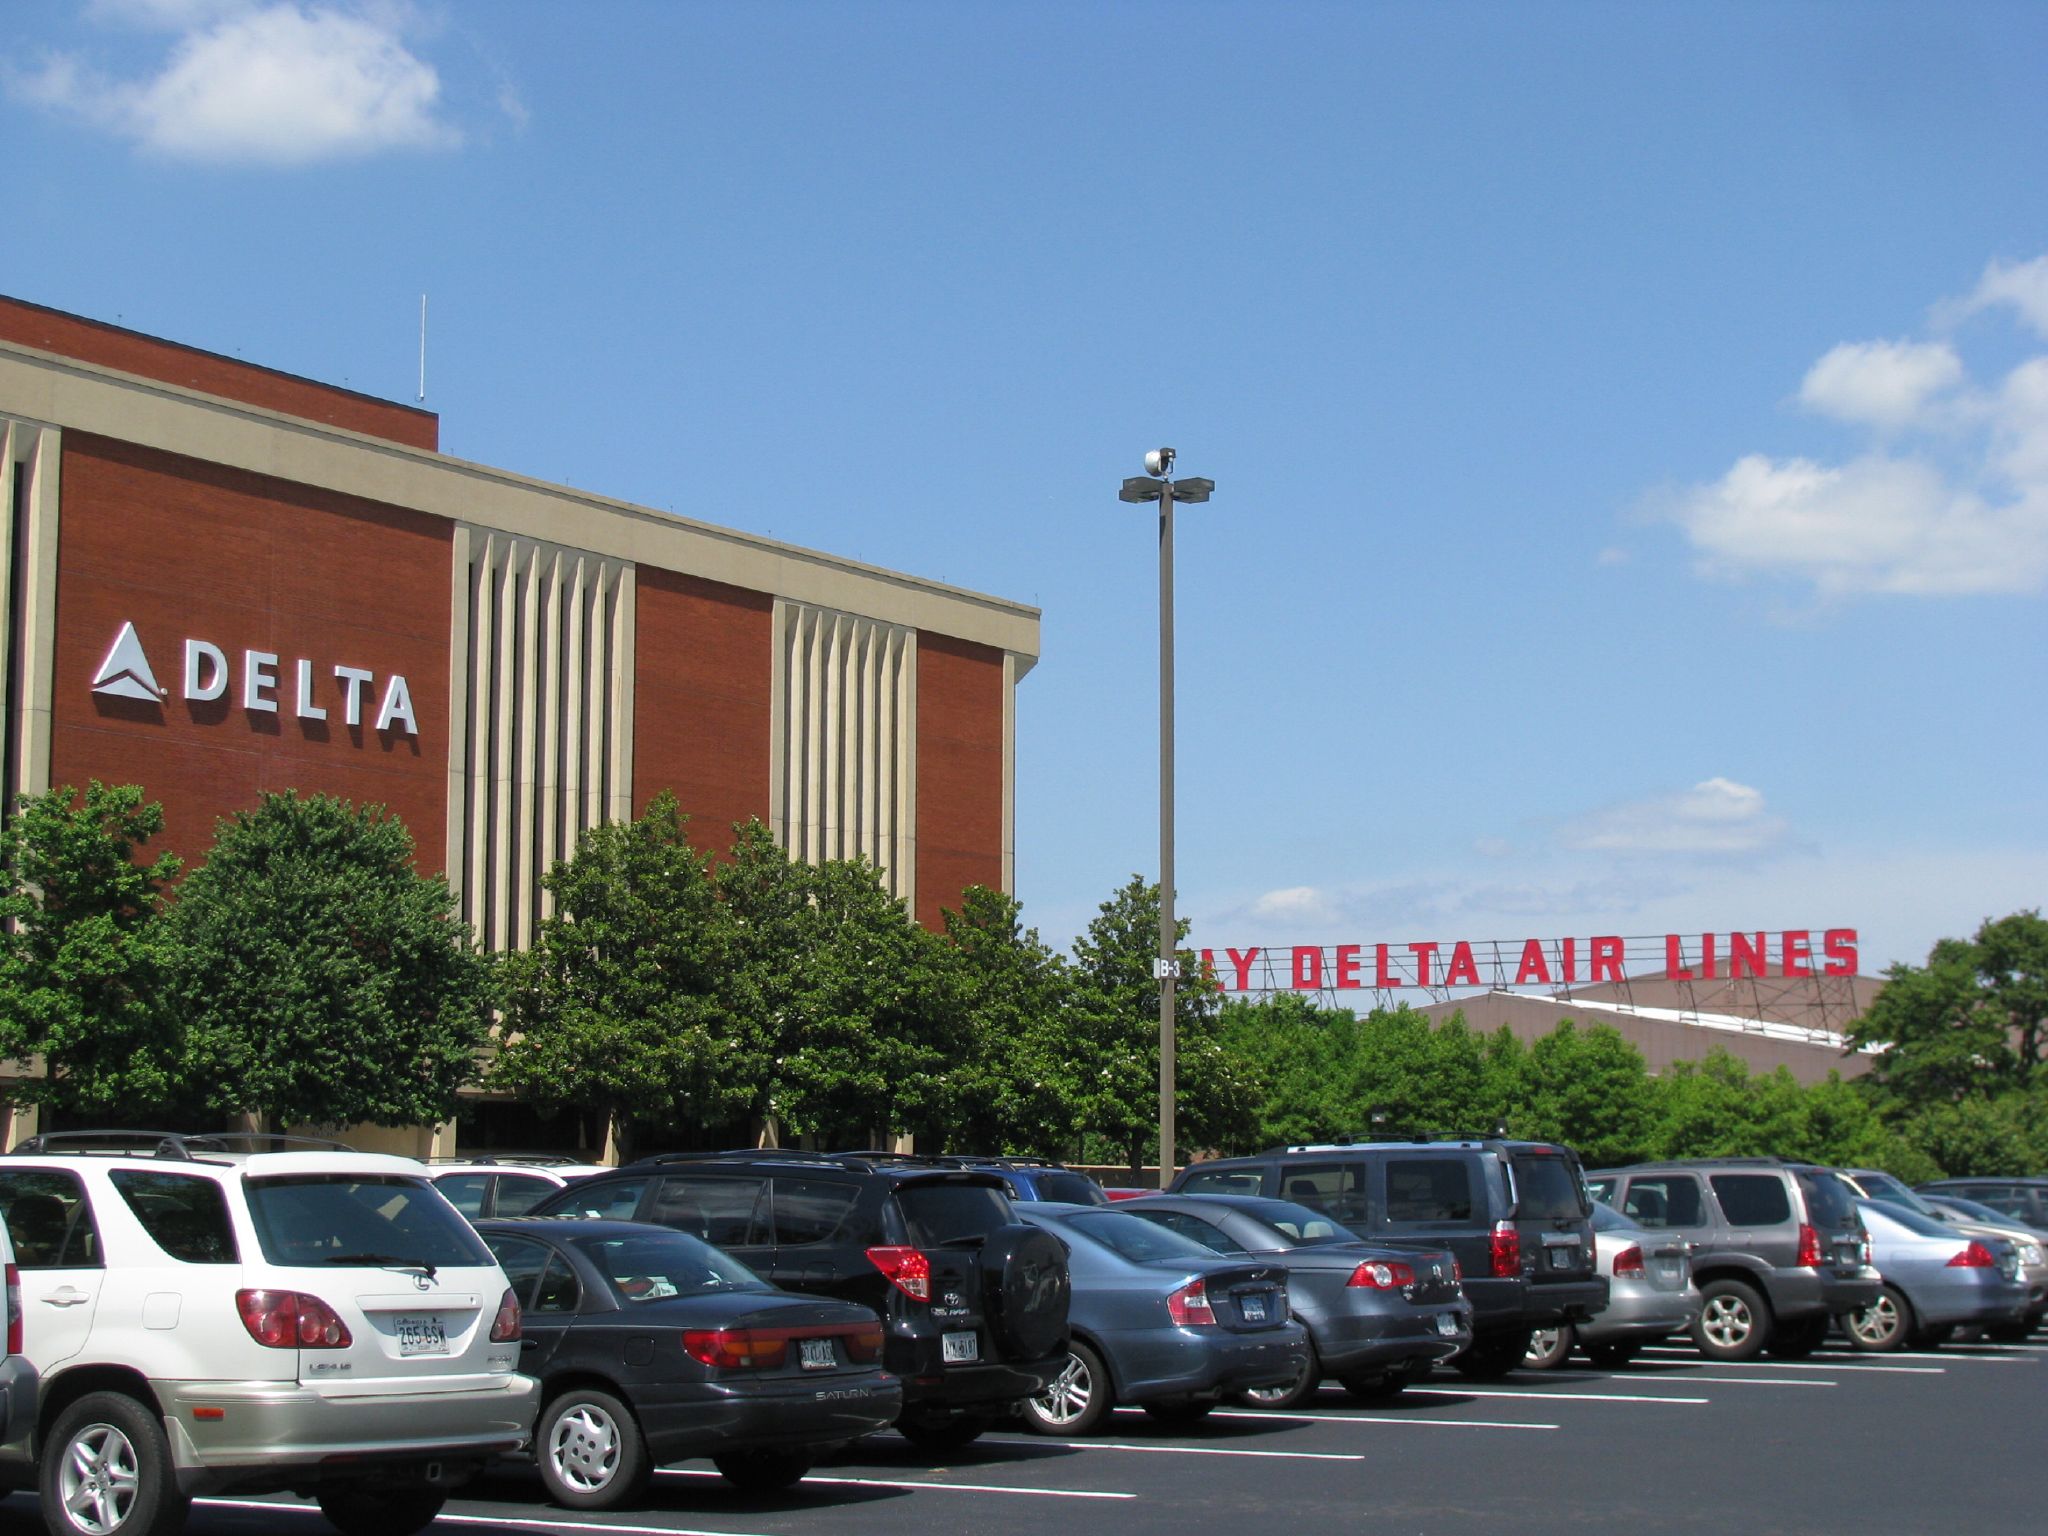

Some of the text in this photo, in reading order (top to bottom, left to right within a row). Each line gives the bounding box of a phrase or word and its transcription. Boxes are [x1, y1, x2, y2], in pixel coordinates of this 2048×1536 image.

[183, 638, 419, 735] DELTA
[1160, 959, 1181, 978] B-3
[1292, 940, 1480, 990] DELTA
[1515, 936, 1625, 985] AIR
[1665, 928, 1858, 982] LINES
[399, 1326, 422, 1346] 265
[815, 1387, 869, 1401] SATURN
